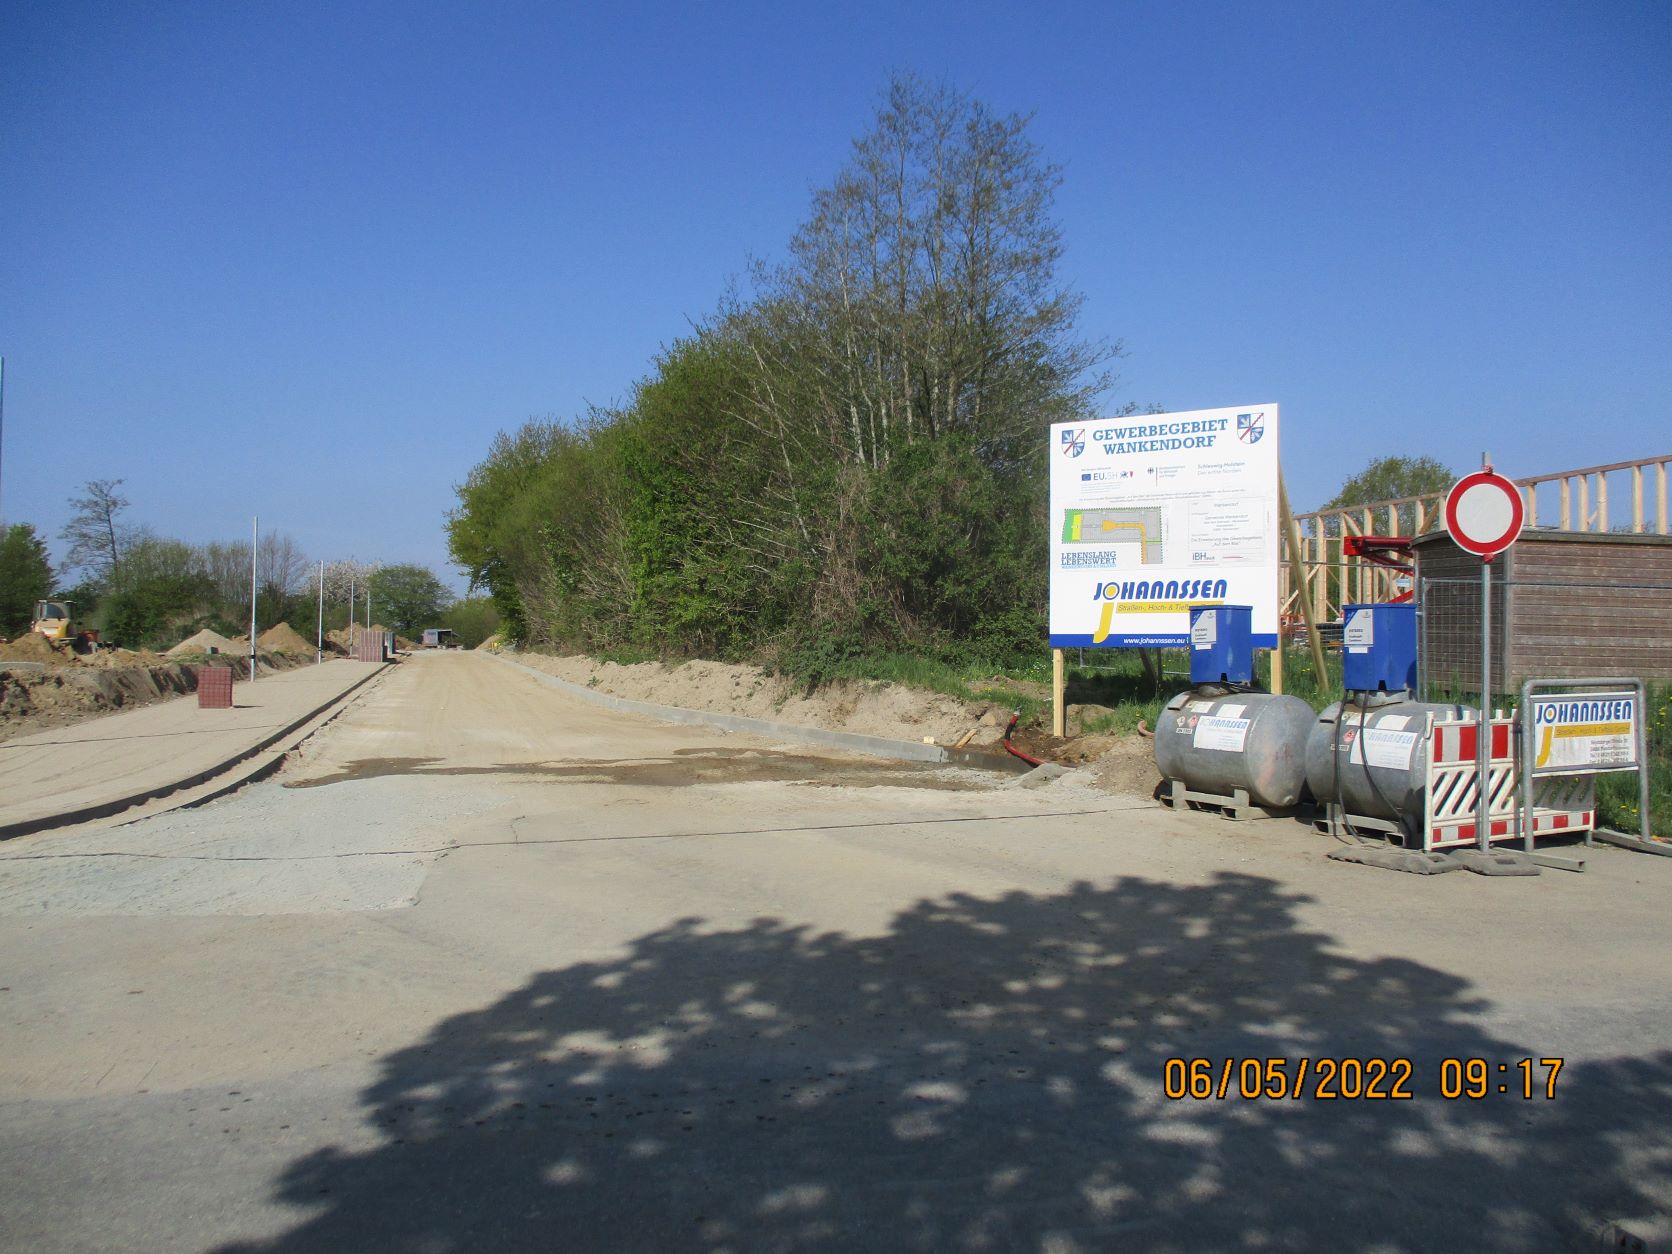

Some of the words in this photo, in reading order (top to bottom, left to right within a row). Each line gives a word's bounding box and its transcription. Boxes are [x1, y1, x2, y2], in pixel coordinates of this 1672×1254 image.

[1092, 418, 1228, 441] GEWERBEGEBIET
[1103, 435, 1217, 455] WANKENDORF
[1061, 551, 1117, 560] LEBENSLANG
[1061, 557, 1117, 566] LEBENSWERT
[1093, 579, 1228, 600] JOHANNSSEN
[1123, 637, 1186, 645] www.johannssen.eu
[1536, 700, 1632, 724] JOHANNSSEN
